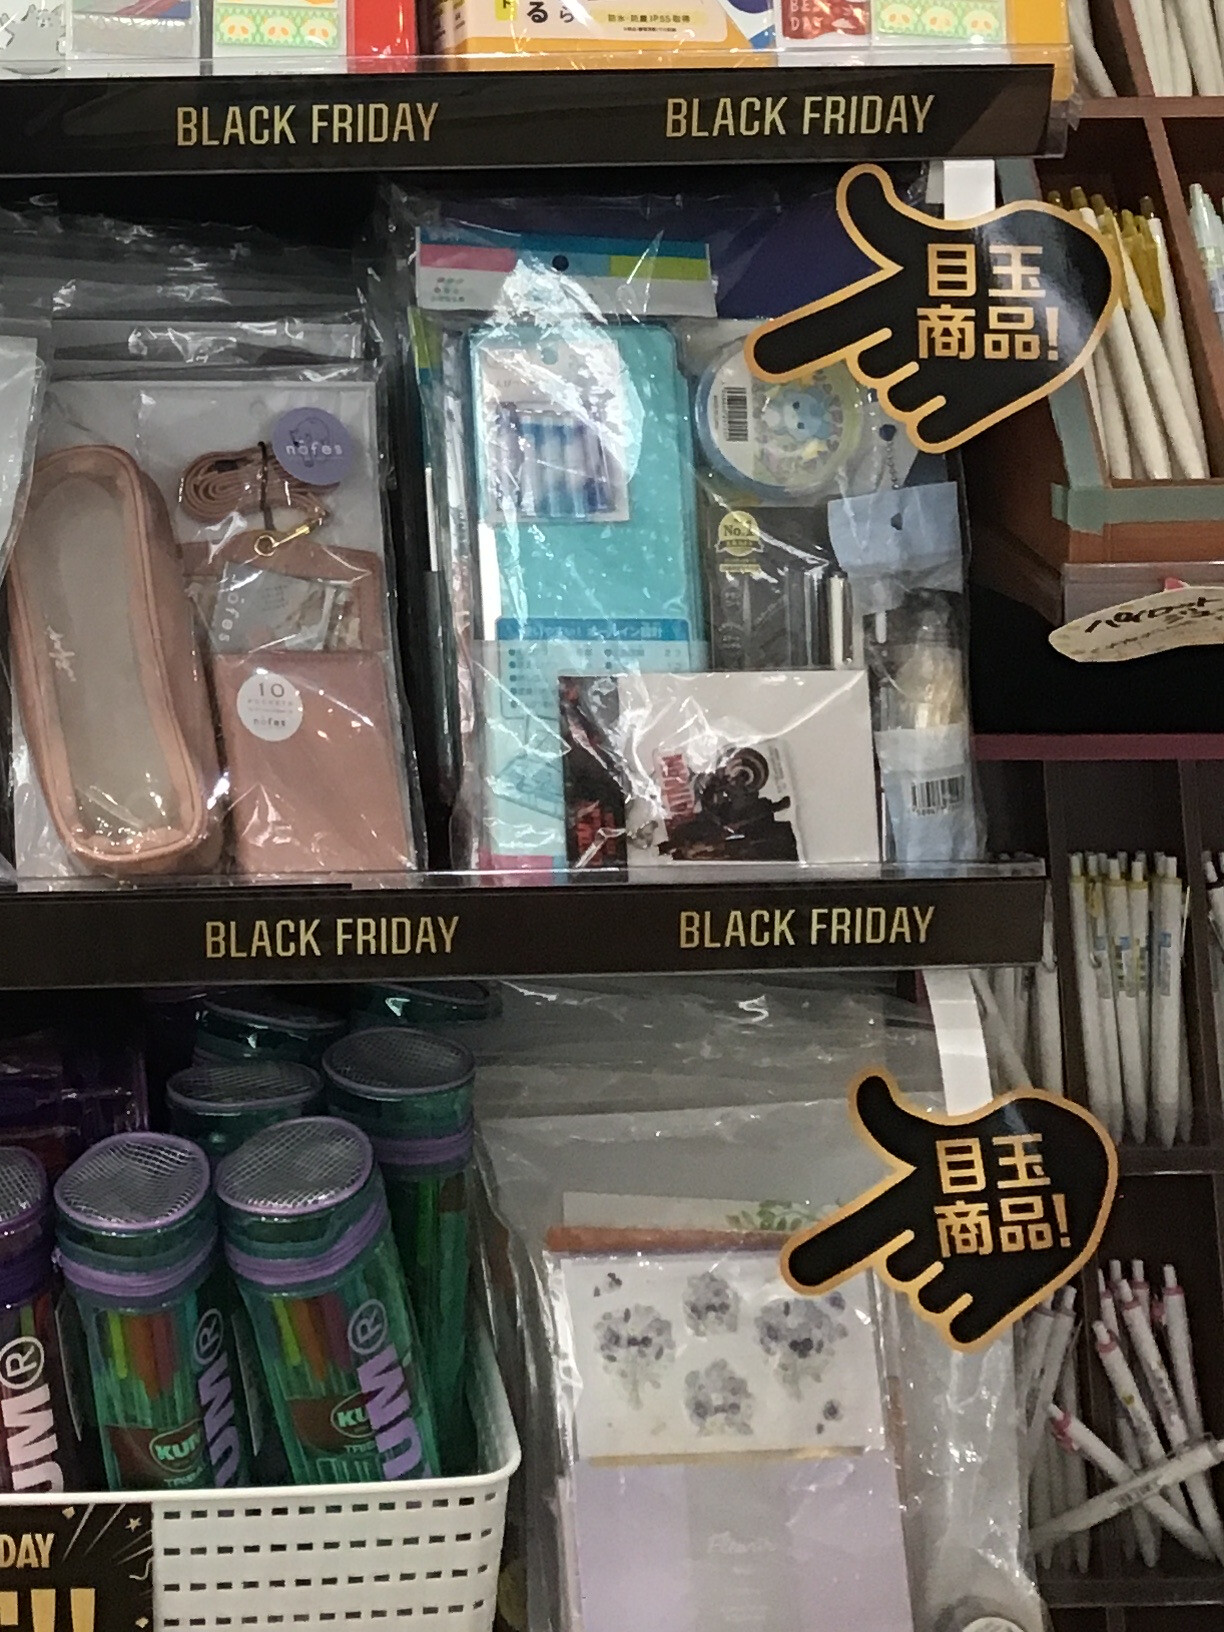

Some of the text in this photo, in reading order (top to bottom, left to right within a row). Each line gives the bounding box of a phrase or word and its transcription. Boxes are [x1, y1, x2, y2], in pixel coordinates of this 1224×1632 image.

[177, 102, 439, 146] BLACK FRIDAY
[666, 94, 935, 138] BLACK FRIDAY
[927, 243, 1046, 298] 目玉
[916, 303, 1059, 361] 商品!
[259, 682, 285, 698] 10
[205, 916, 459, 958] BLACK FRIDAY
[680, 906, 935, 949] BLACK FRIDAY
[935, 1132, 1051, 1195] 目玉
[933, 1194, 1071, 1259] 商品!
